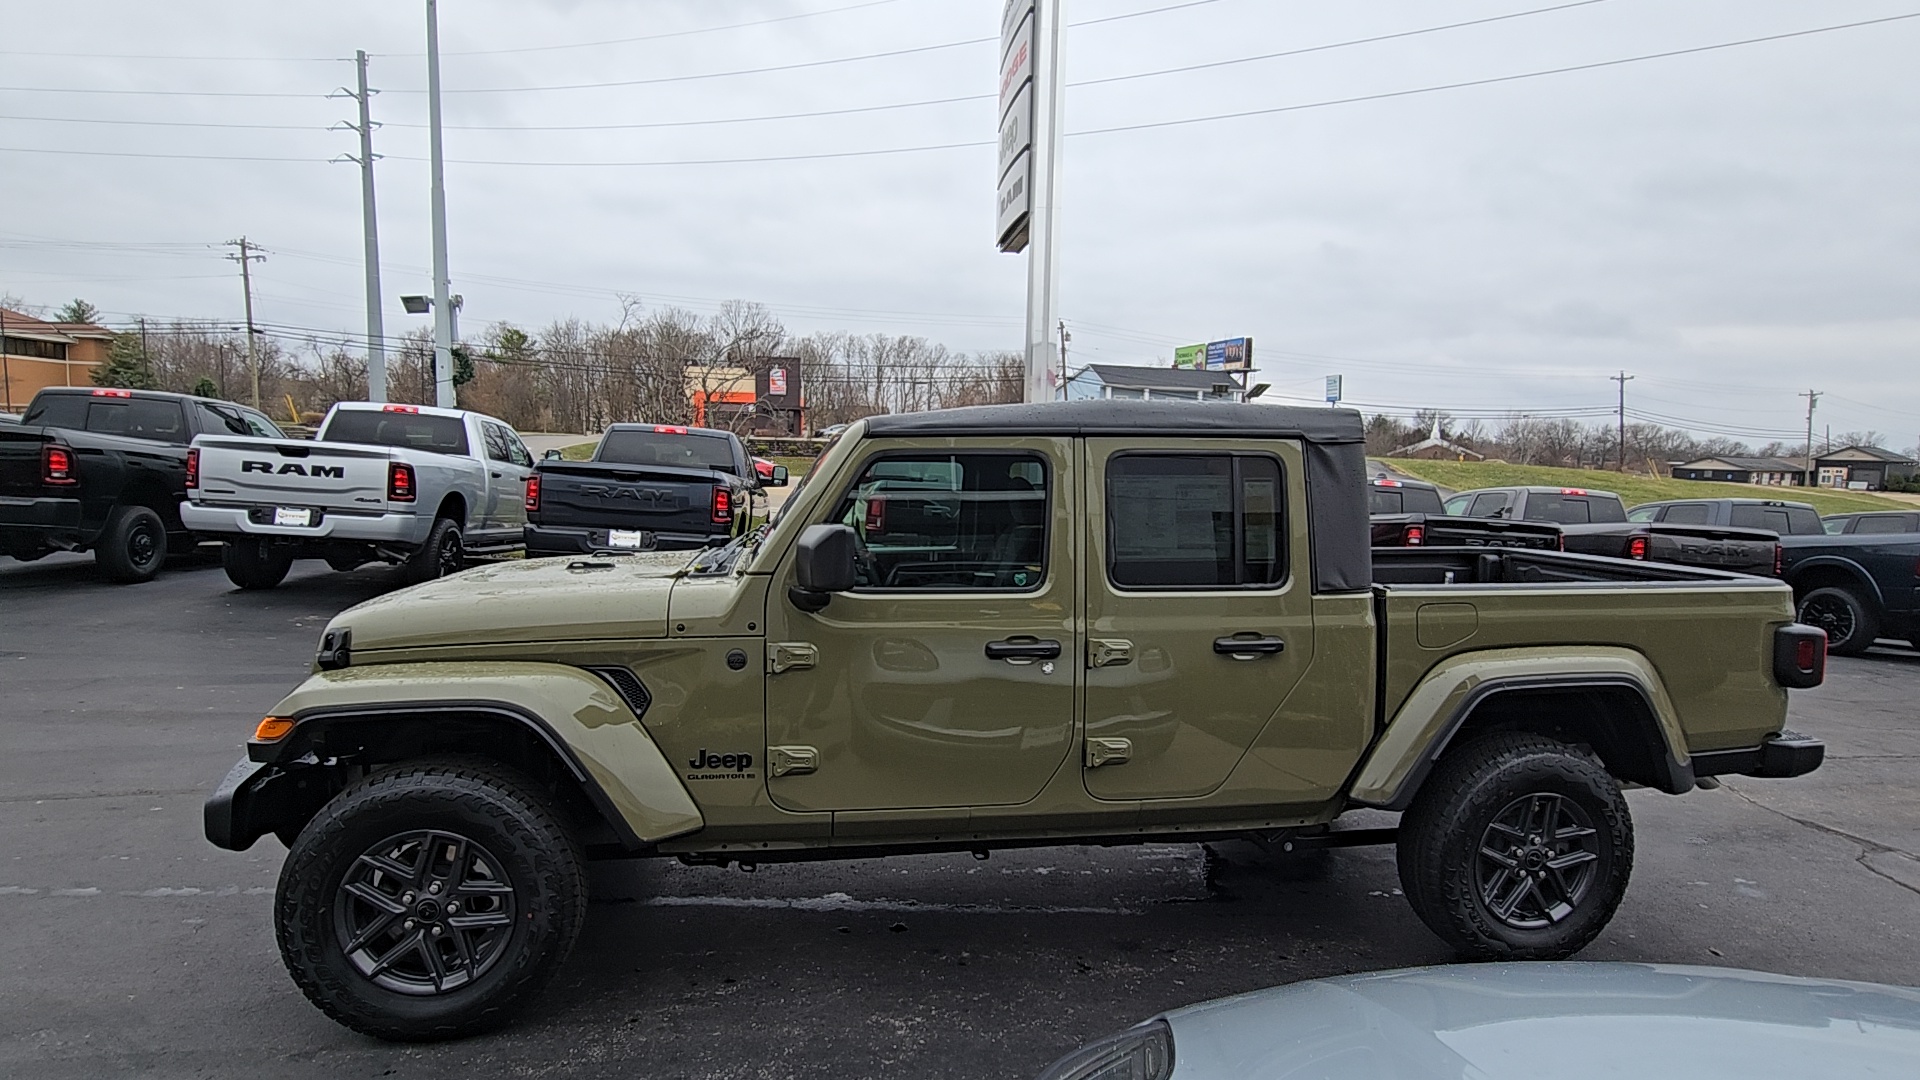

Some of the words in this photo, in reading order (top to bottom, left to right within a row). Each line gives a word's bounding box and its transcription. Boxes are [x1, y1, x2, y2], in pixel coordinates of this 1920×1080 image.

[242, 460, 344, 478] RAM
[581, 484, 672, 501] RAM
[1681, 543, 1750, 557] RAM
[689, 748, 753, 772] Jeep
